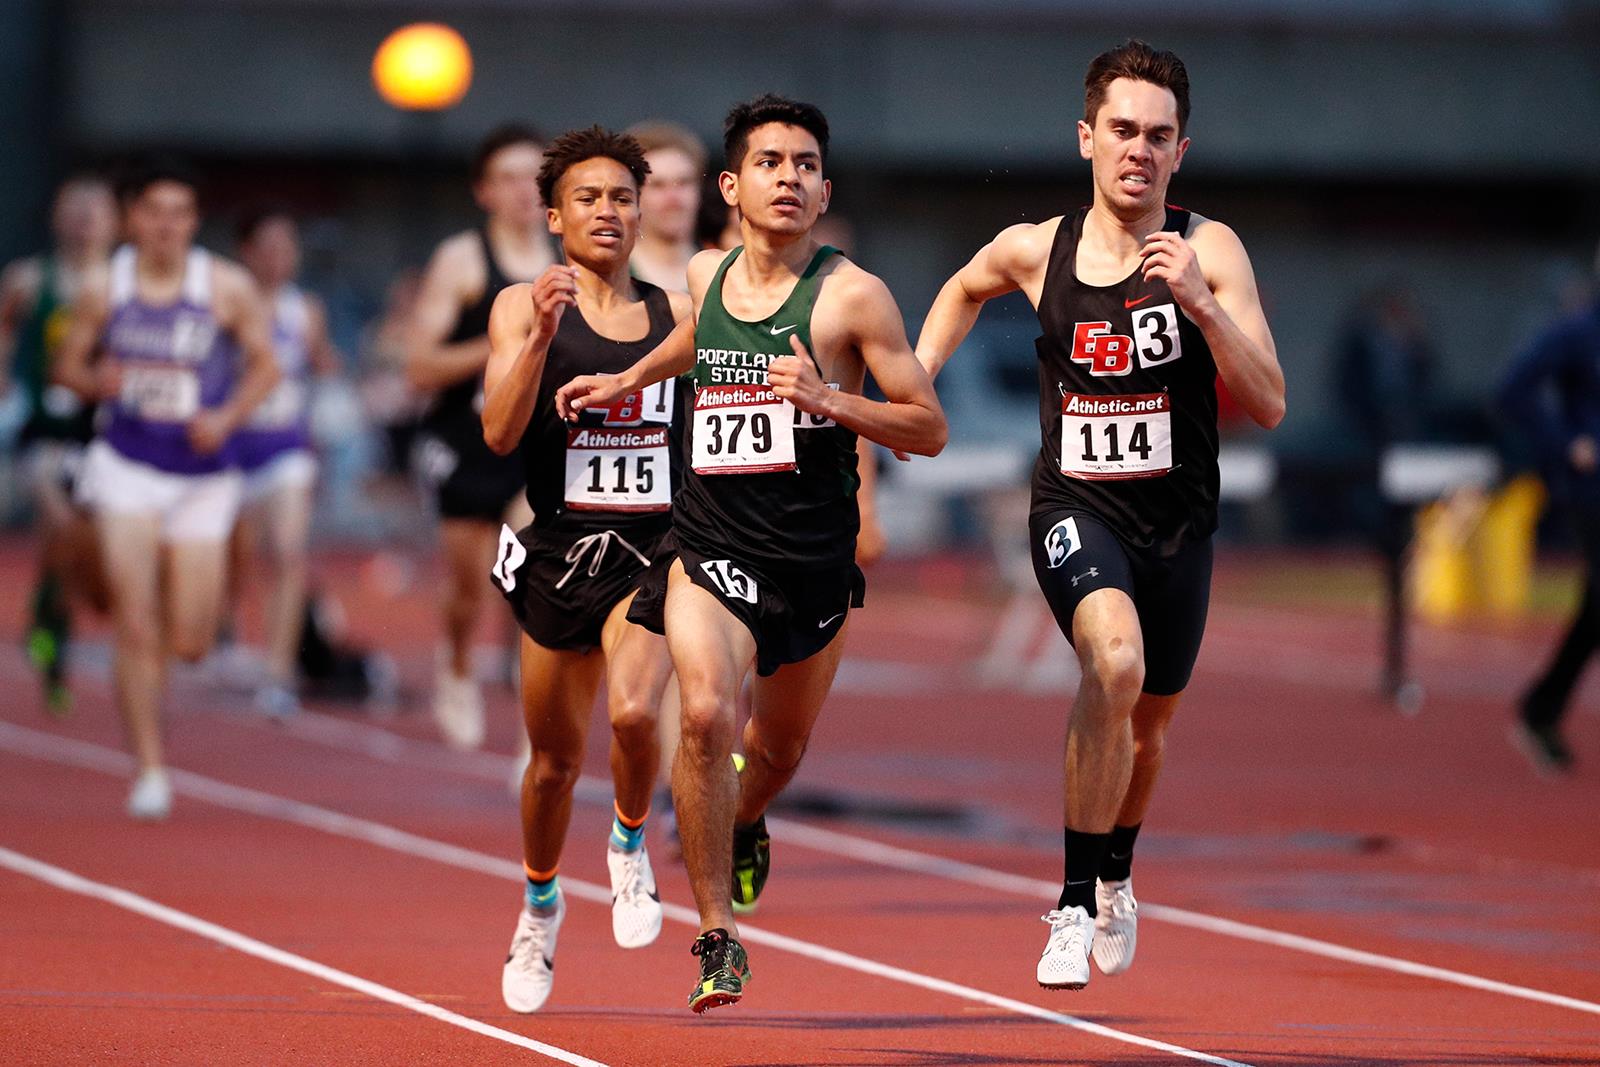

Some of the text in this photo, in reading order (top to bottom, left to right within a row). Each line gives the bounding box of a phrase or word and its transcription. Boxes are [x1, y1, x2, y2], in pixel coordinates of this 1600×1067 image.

[1070, 321, 1135, 377] EB
[1138, 311, 1173, 362] 3
[697, 348, 796, 368] PORTLA
[1066, 396, 1163, 414] Athletic.net
[571, 430, 666, 447] Athletic.net
[706, 412, 772, 456] 379
[1080, 422, 1152, 461] 114
[587, 455, 654, 494] 115
[1048, 525, 1072, 567] 3
[707, 562, 748, 598] 15
